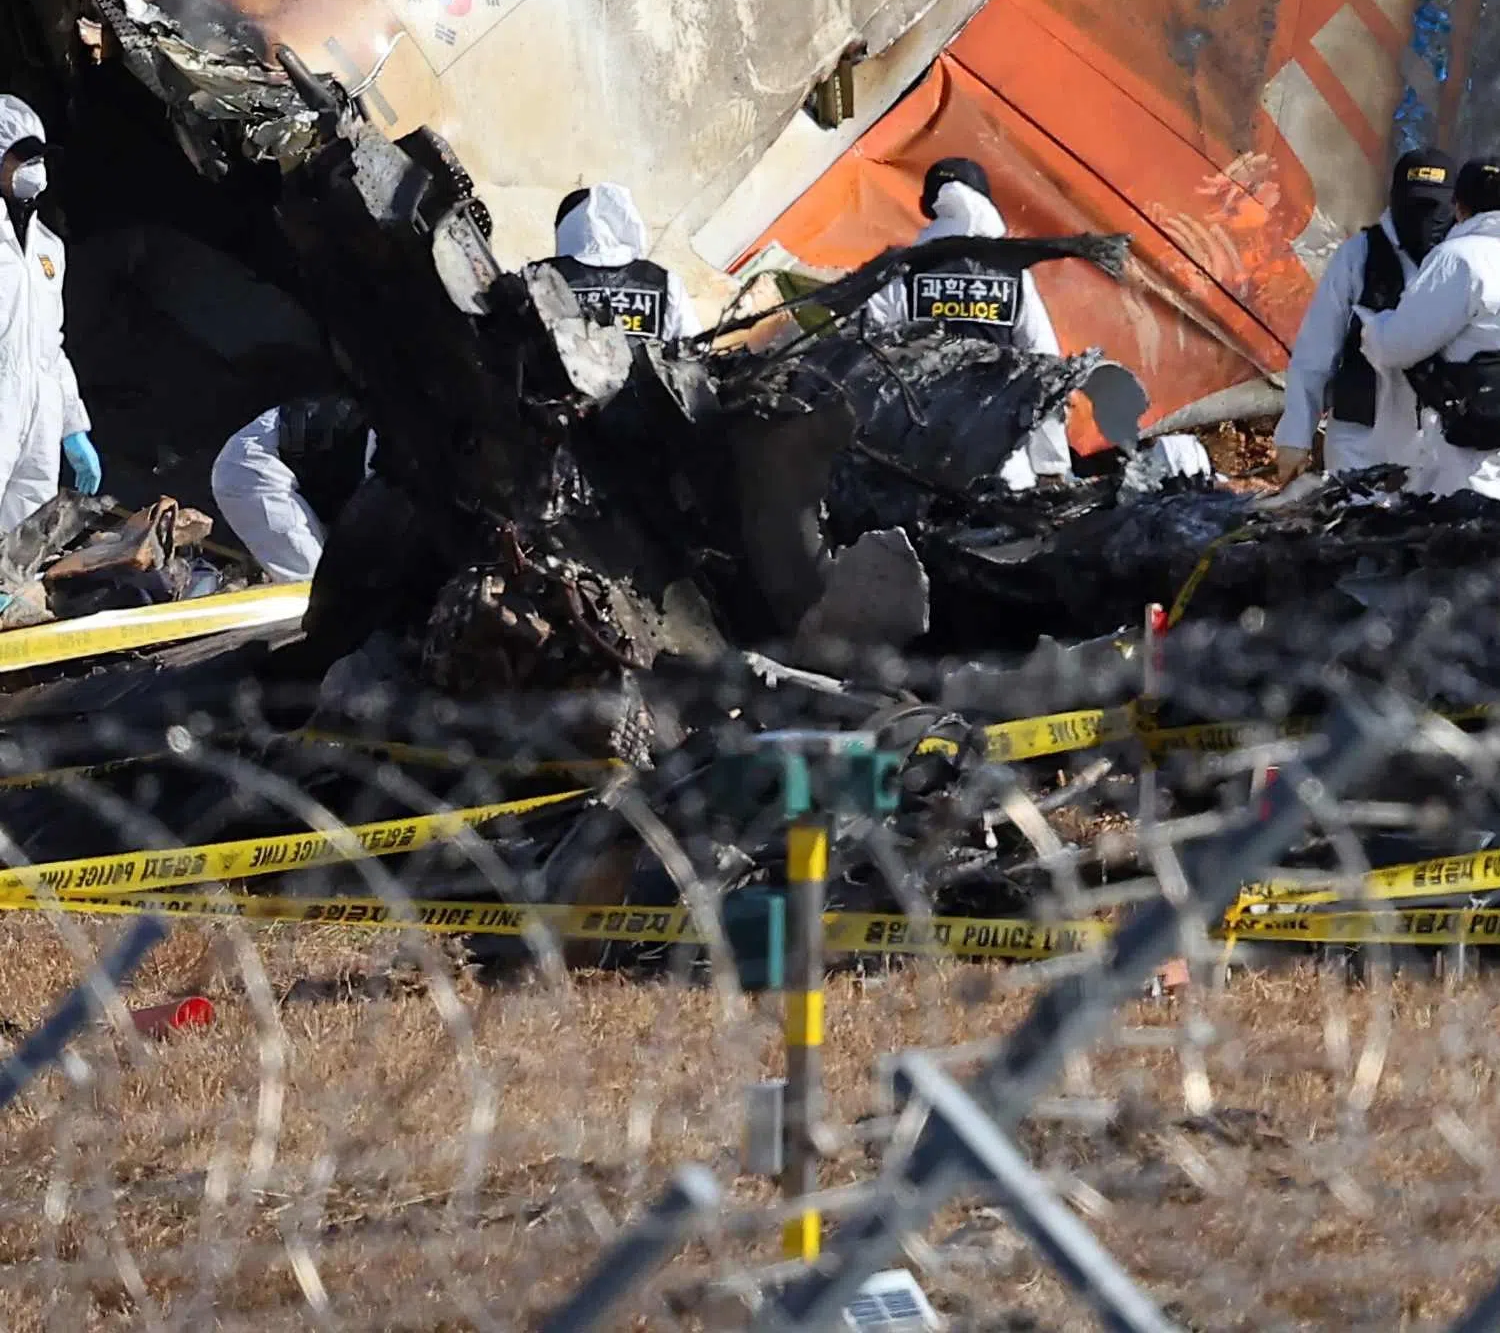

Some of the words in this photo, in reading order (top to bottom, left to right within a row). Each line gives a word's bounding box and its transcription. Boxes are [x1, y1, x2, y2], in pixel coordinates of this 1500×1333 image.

[921, 278, 1011, 302] 과학수사
[931, 301, 1001, 319] POLICE
[963, 923, 1035, 949] POLICE
